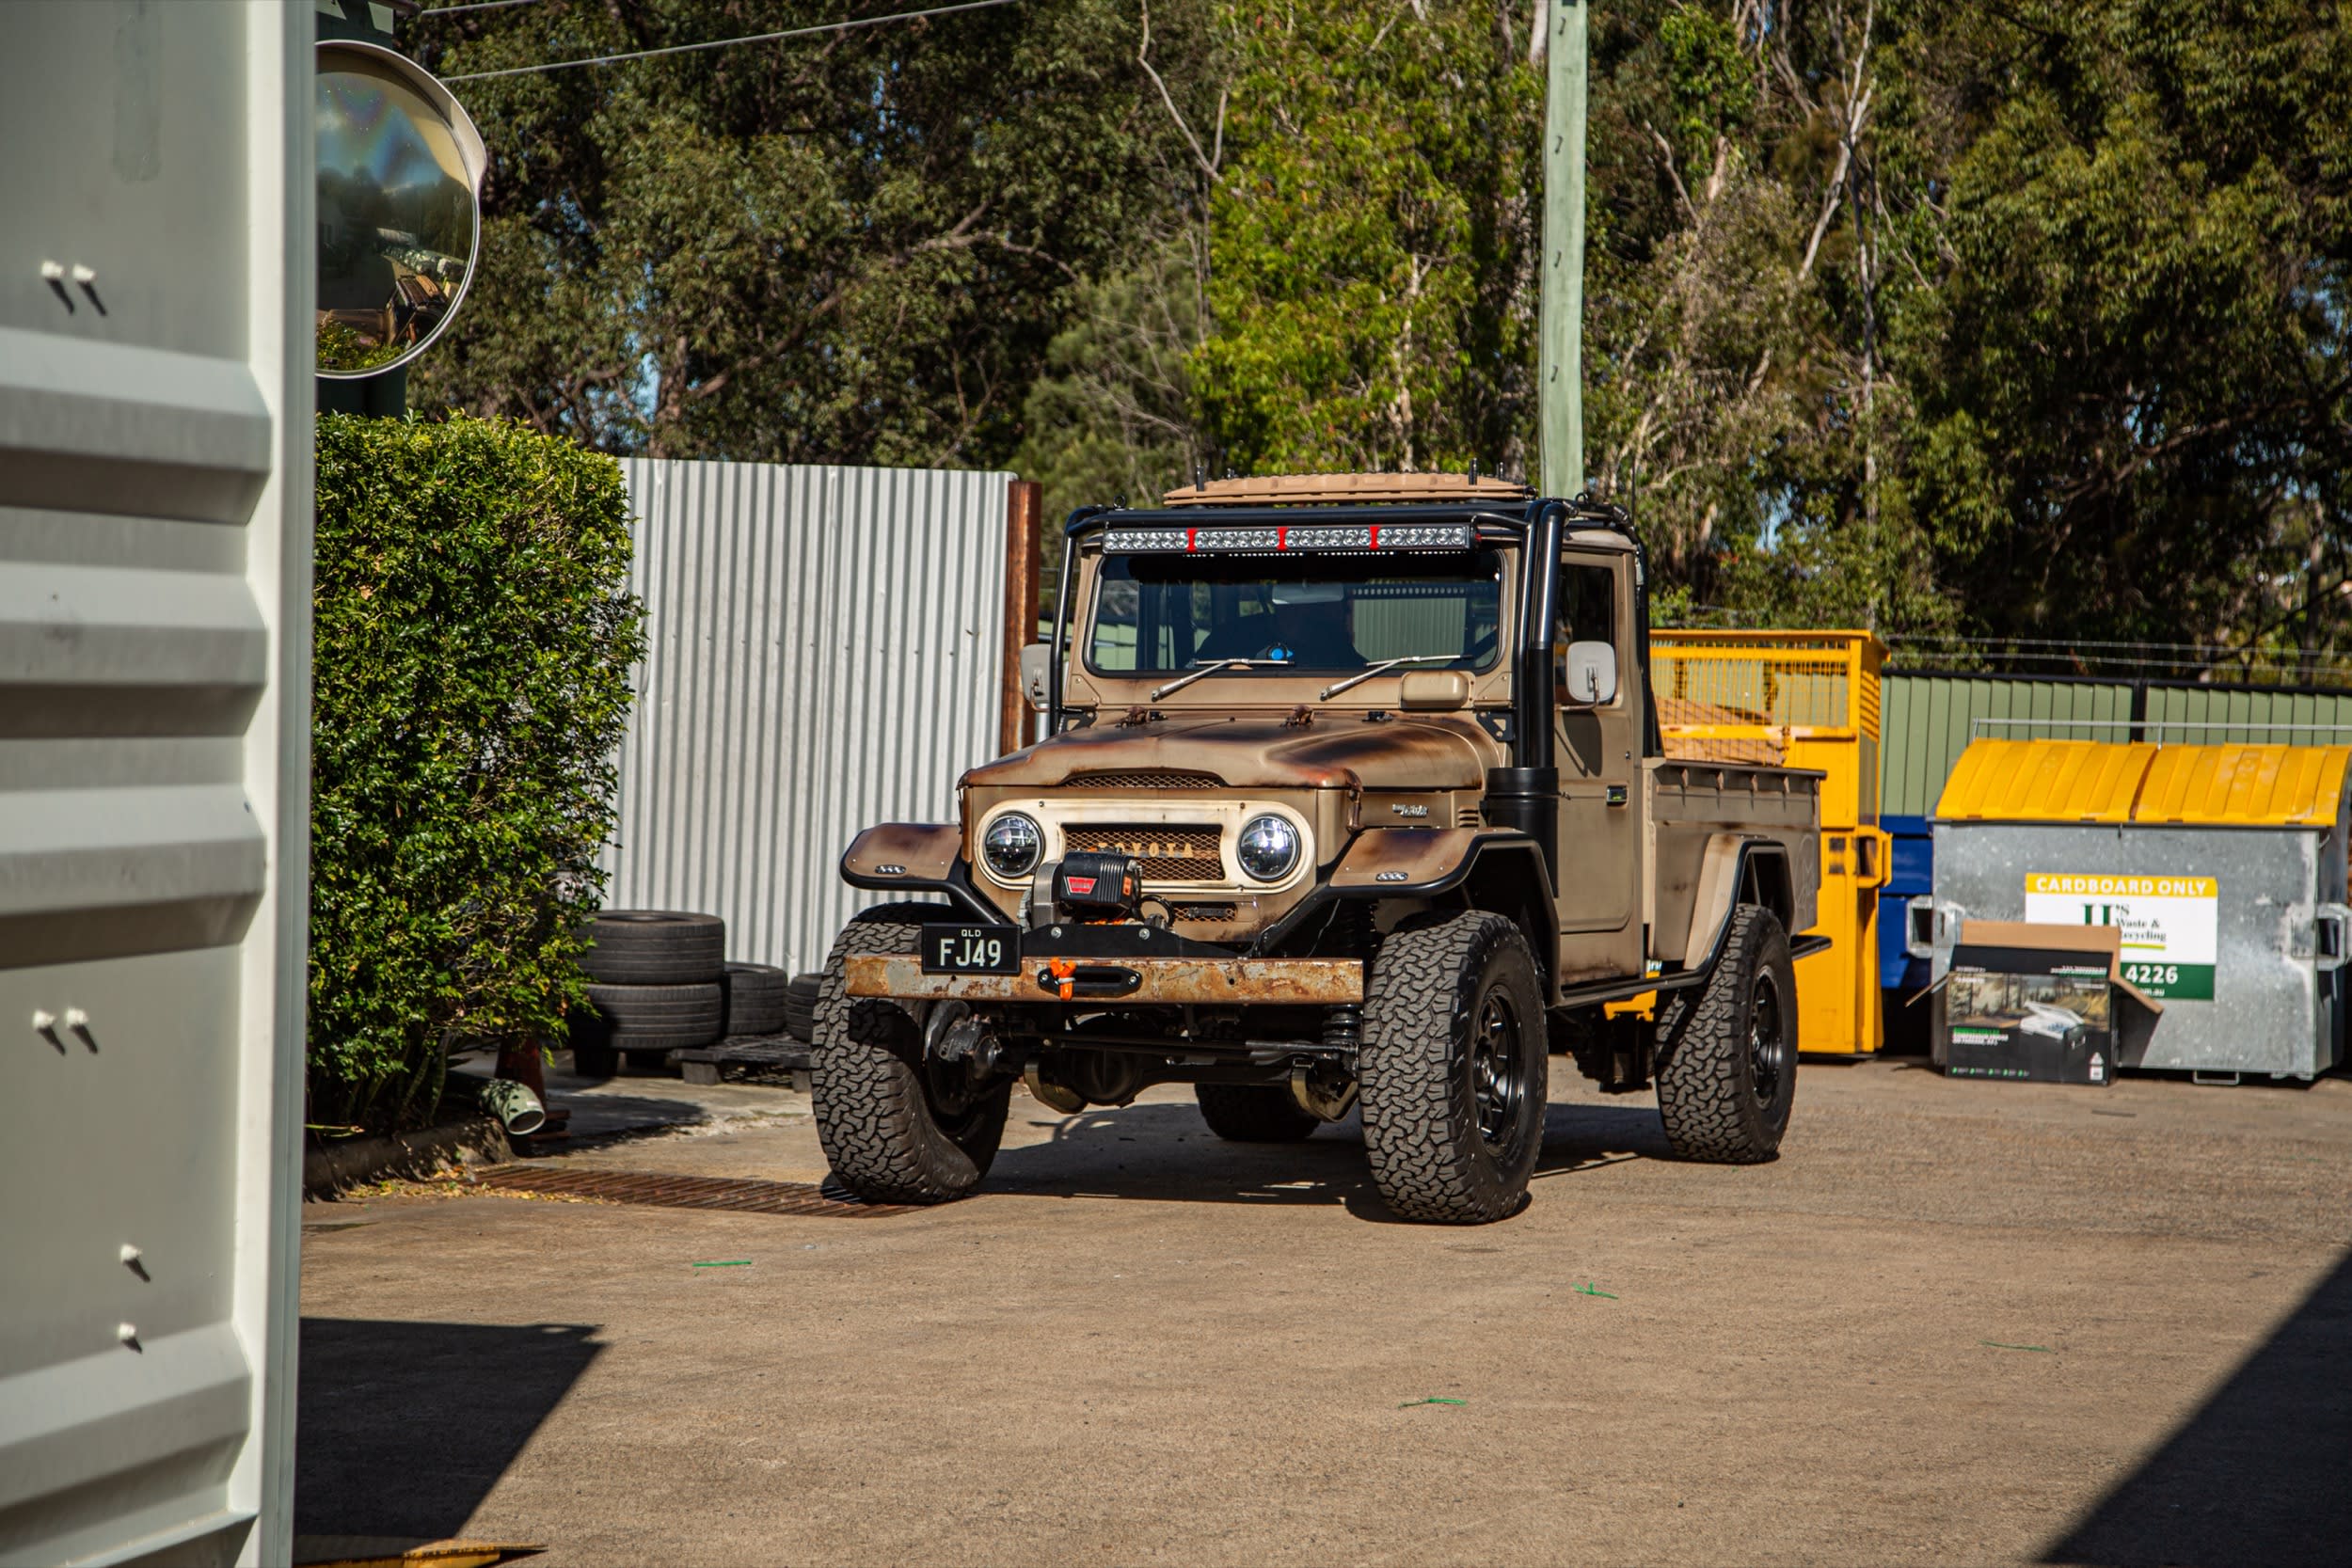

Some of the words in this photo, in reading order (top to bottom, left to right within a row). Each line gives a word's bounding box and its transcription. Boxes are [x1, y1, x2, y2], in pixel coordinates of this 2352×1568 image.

[2036, 878, 2153, 895] CARDBOARD
[2158, 879, 2207, 895] ONLY
[2122, 929, 2167, 942] ecycling
[940, 939, 1001, 967] FJ49
[2126, 965, 2178, 984] 4226
